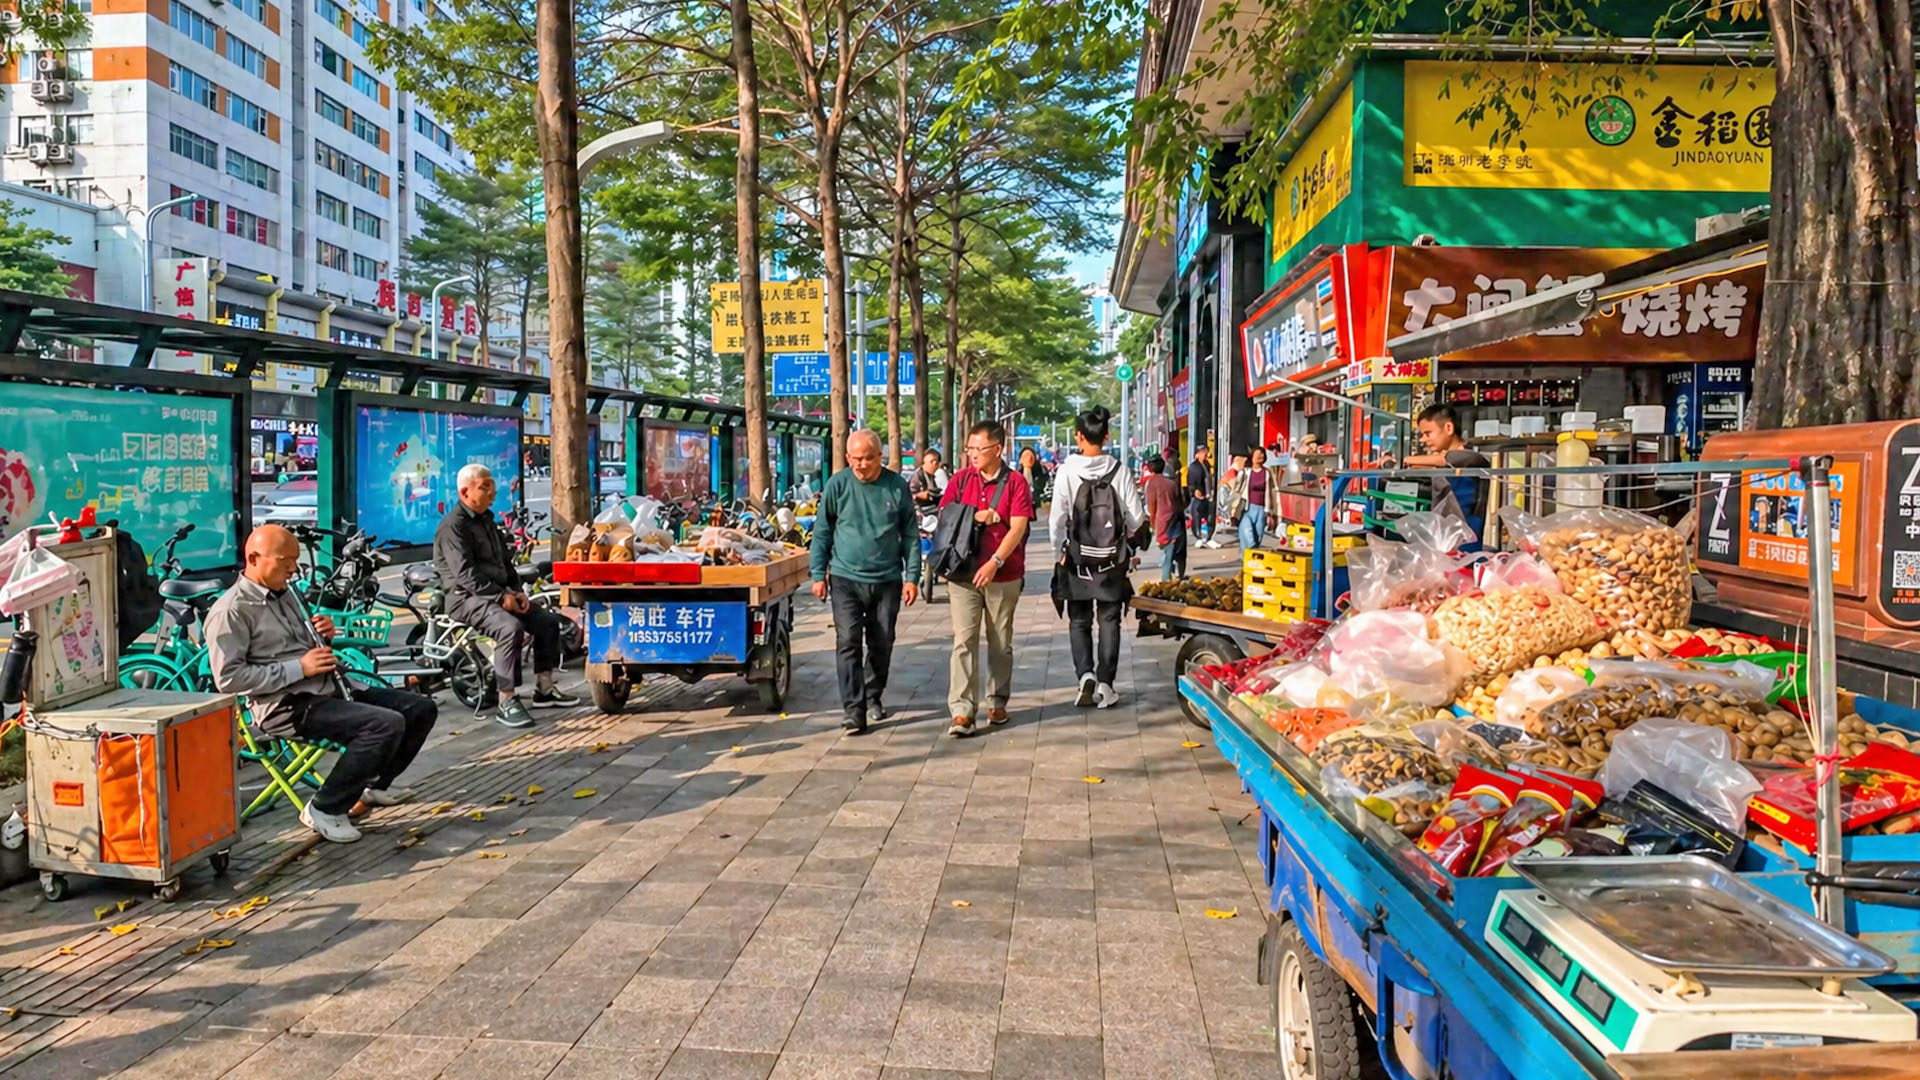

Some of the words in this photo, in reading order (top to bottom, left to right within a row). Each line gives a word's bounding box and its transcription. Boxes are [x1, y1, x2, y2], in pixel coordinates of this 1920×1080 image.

[1672, 150, 1764, 167] JINDAOYUAN
[1620, 279, 1748, 338] 烧烤
[676, 606, 715, 629] 车行
